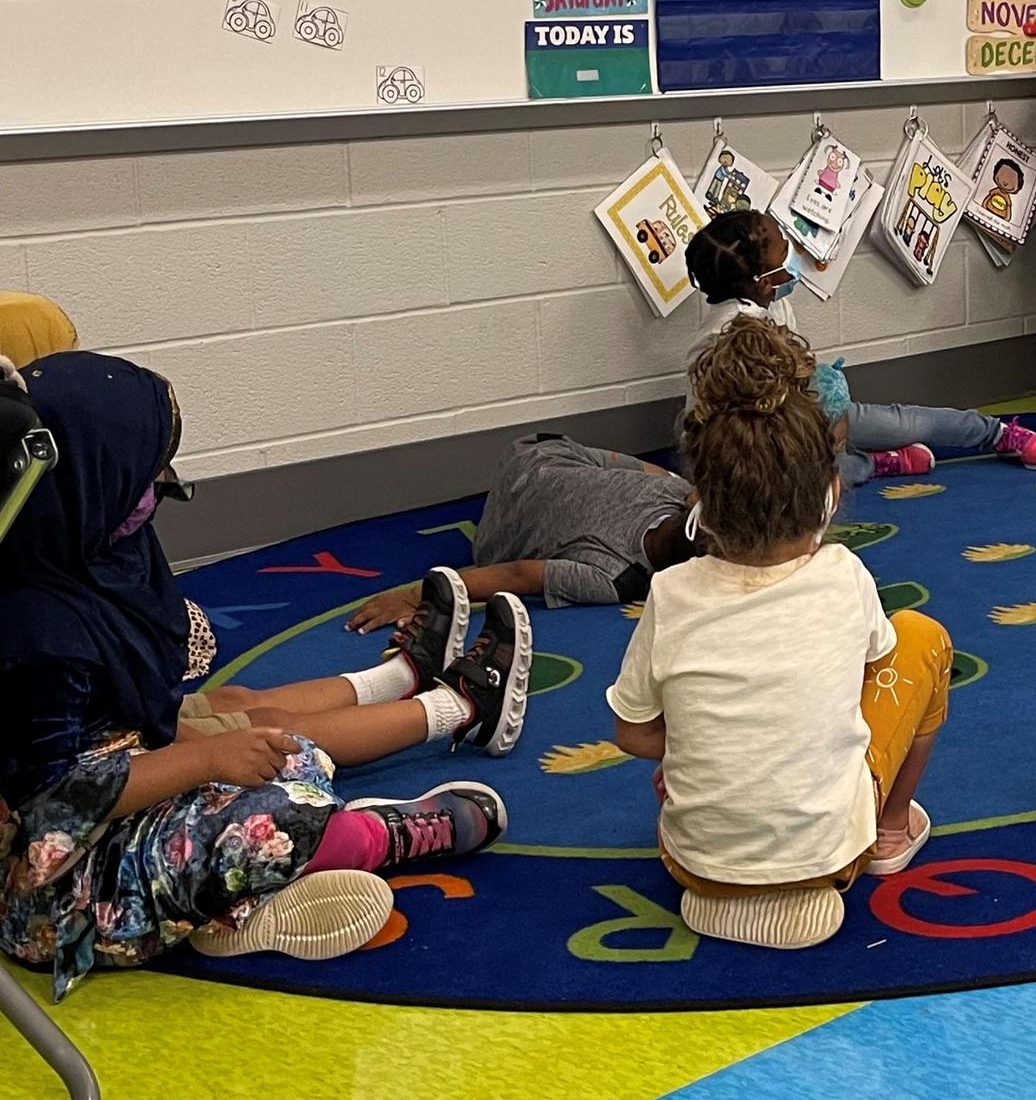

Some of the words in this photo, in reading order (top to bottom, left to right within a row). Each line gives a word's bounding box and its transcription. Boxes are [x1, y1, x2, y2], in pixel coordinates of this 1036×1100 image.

[534, 26, 610, 46] TODAY
[613, 25, 635, 44] IS
[1006, 141, 1030, 163] HONEST
[922, 155, 952, 188] Let's
[659, 194, 695, 245] Rules
